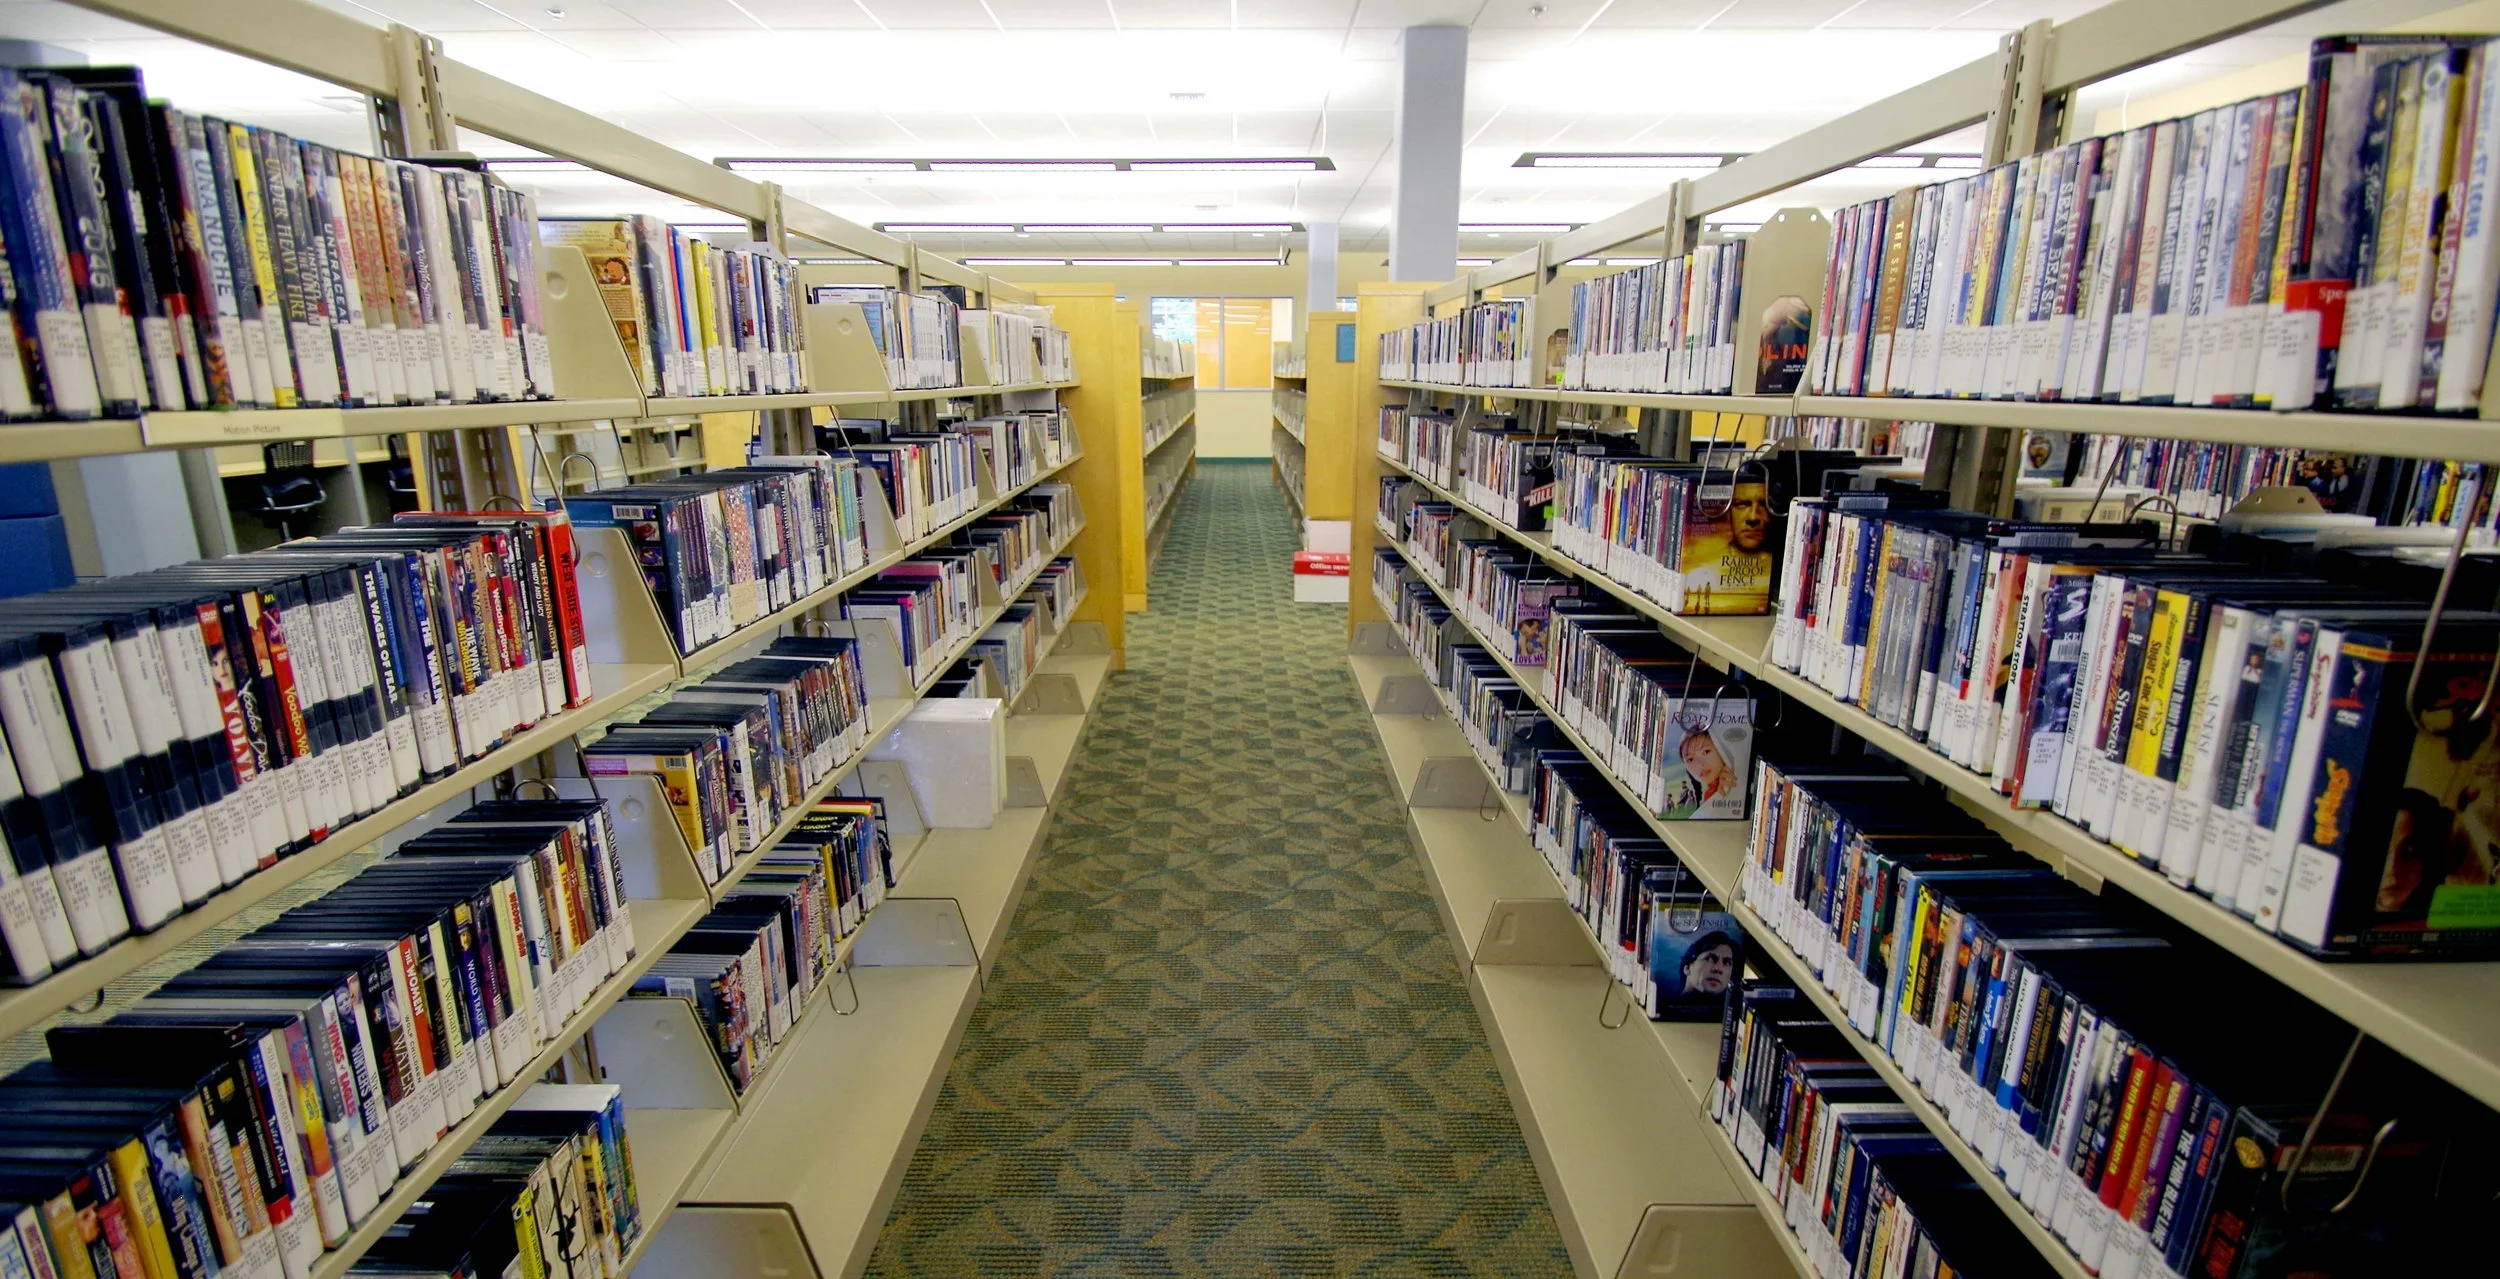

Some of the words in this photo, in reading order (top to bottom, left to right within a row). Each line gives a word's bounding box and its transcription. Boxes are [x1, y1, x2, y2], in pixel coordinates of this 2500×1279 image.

[193, 160, 215, 209] UNA
[263, 157, 289, 218] UNDER
[2053, 182, 2074, 236] SEXY
[2257, 195, 2278, 237] SON
[2462, 182, 2484, 239] LOUIS
[1891, 220, 1905, 251] THE
[2063, 212, 2081, 250] SIDE
[2139, 225, 2158, 255] SIN
[78, 215, 112, 289] 2046
[203, 215, 233, 297] NOCHE
[275, 223, 299, 277] HEAVY
[1909, 237, 1926, 294] SECRETS
[1925, 249, 1934, 262] A
[2187, 197, 2216, 316] SPEECHLESS
[2428, 180, 2465, 323] SPELLBOUND
[2039, 249, 2063, 315] BEAST
[2134, 260, 2154, 304] ALAS
[285, 284, 306, 318] FIRE
[1625, 282, 1640, 339] PERSONA
[1904, 297, 1917, 325] LIES
[529, 561, 539, 586] WENDY
[1722, 555, 1759, 567] RABBIT
[1730, 566, 1765, 576] PROOF
[361, 570, 375, 597] THE
[533, 586, 542, 600] AND
[1720, 575, 1756, 586] FENCE
[535, 600, 544, 618] LUCY
[564, 586, 577, 617] SIDE
[369, 600, 387, 648] WAGES
[418, 616, 435, 648] THE
[464, 625, 476, 647] THE
[2014, 594, 2030, 649] STRATTON
[2101, 599, 2117, 642] Streetcar
[379, 649, 392, 669] OF
[455, 619, 473, 683] WATERMELON
[467, 646, 481, 678] WAVE
[499, 632, 512, 669] Ringer
[2094, 644, 2109, 673] Named
[2143, 639, 2162, 673] Sugar
[2007, 651, 2020, 686] STORY
[2172, 658, 2192, 692] SUNDAY
[2280, 649, 2306, 718] SUPERMAN
[2305, 648, 2331, 720] Suspicion
[382, 670, 398, 705] FEAR
[2072, 687, 2085, 710] OUTTA
[2089, 674, 2104, 701] Desire
[2139, 674, 2155, 702] Cane
[282, 685, 304, 736] Voodoo
[1671, 712, 1708, 725] ROAD
[1713, 711, 1749, 725] HOME
[2102, 687, 2131, 761] Stroszek
[2132, 704, 2151, 732] Alley
[2166, 692, 2186, 725] BLOODY
[2182, 680, 2210, 743] SWEET
[2197, 694, 2221, 755] SUNRISE
[2160, 725, 2180, 760] SUNDAY
[1833, 874, 1846, 901] TAE
[507, 892, 522, 932] WRONG
[1830, 902, 1842, 930] GUK
[403, 949, 414, 966] THE
[405, 966, 424, 1017] WOMEN
[465, 959, 477, 996] WORLD
[1903, 964, 1914, 993] TAXI
[470, 996, 483, 1024] TRADE
[2034, 986, 2049, 1011] THAT'S
[442, 990, 459, 1042] Woman's
[402, 1014, 412, 1039] WOLF
[408, 1040, 422, 1084] CHILDREN
[2021, 1011, 2044, 1072] ENTERTAINMENT
[2071, 1032, 2088, 1067] there's
[327, 1021, 345, 1063] WINGS
[338, 1073, 357, 1118] EAGLES
[392, 1035, 416, 1099] WATER
[2131, 1067, 2145, 1086] THEY
[2059, 1068, 2079, 1116] something
[2127, 1086, 2139, 1103] DIED
[2149, 1082, 2165, 1108] THEY
[362, 1098, 380, 1133] BONE
[2122, 1103, 2135, 1121] WITH
[2143, 1109, 2158, 1134] WERE
[2053, 1117, 2068, 1146] about
[2117, 1120, 2131, 1142] THEIR
[2176, 1128, 2196, 1156] THE
[2110, 1141, 2126, 1164] BOOTS
[2125, 1134, 2152, 1193] EXPENDABLE
[2194, 1156, 2210, 1178] MAN
[207, 1119, 250, 1240] WINDTALKERS
[2108, 1164, 2119, 1176] ON
[2167, 1155, 2188, 1187] THIN
[2158, 1185, 2178, 1217] BLUE
[2148, 1214, 2170, 1249] LINE
